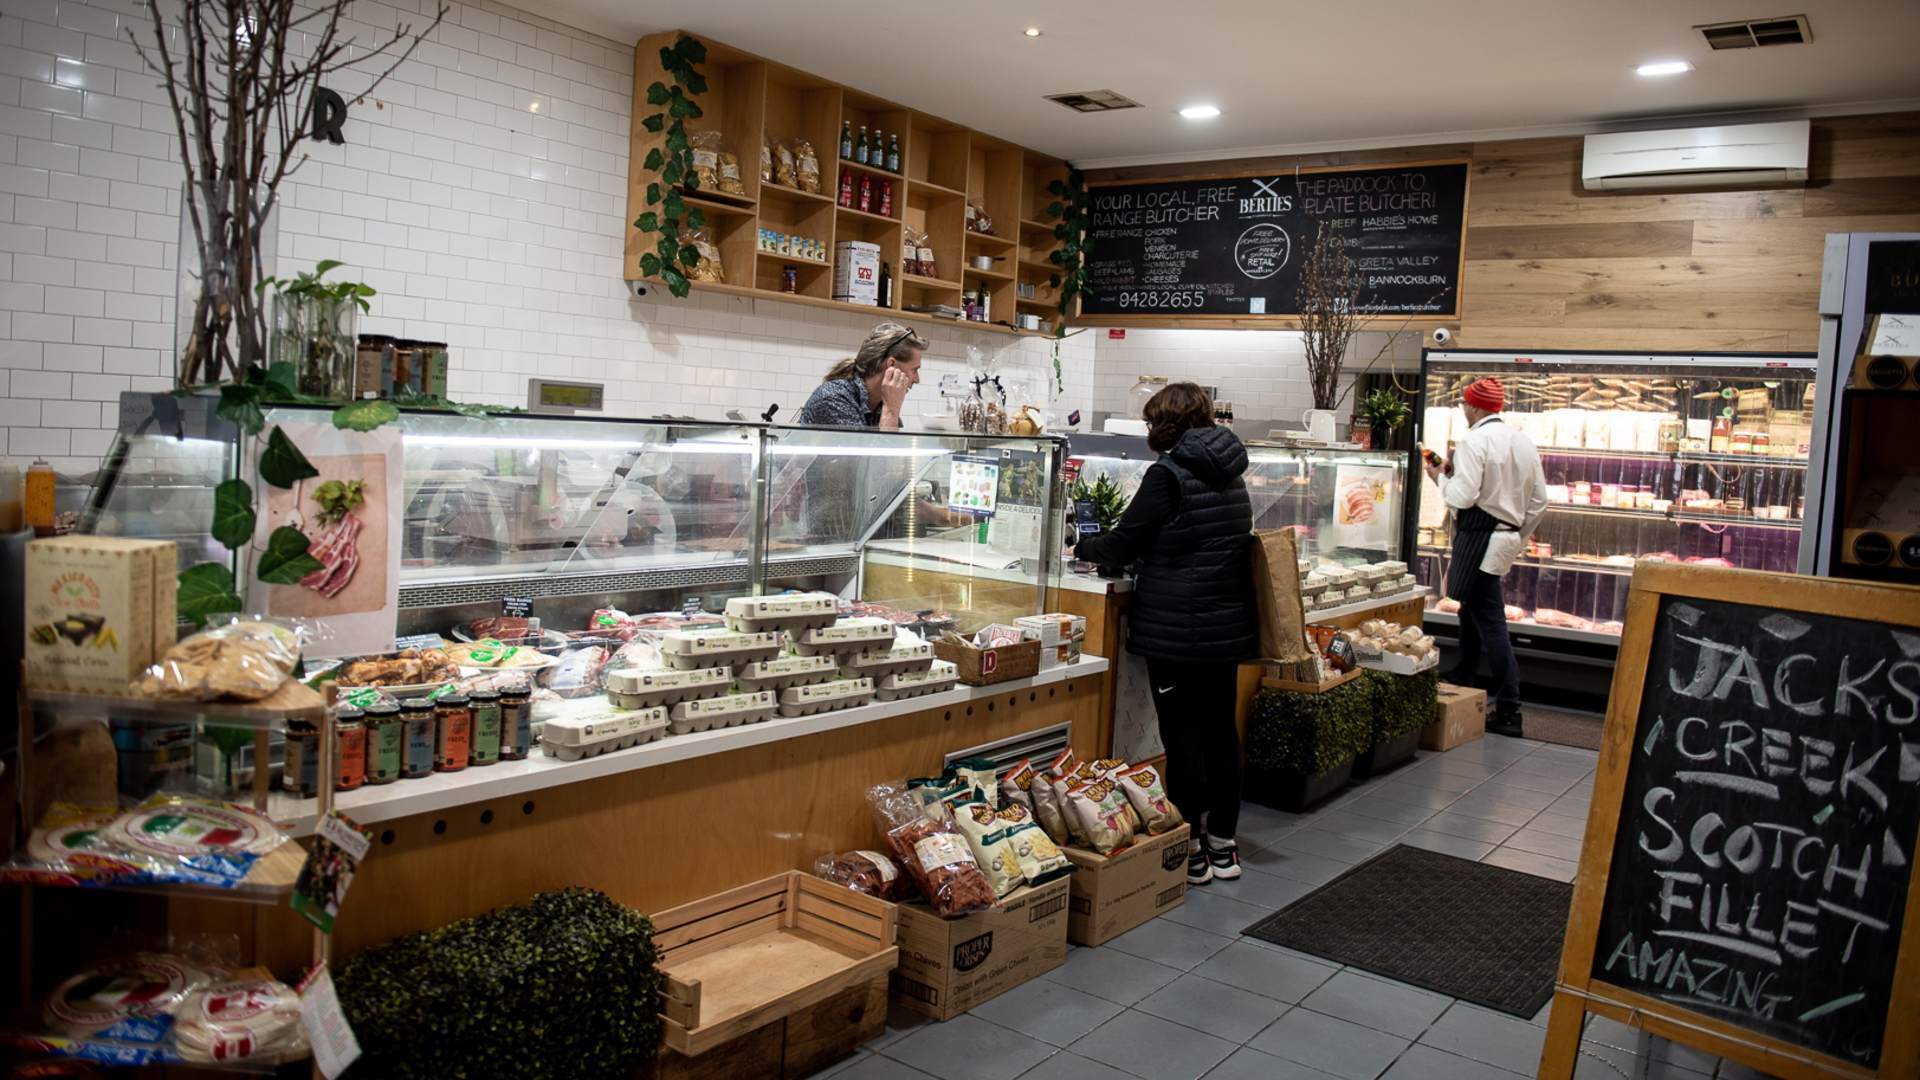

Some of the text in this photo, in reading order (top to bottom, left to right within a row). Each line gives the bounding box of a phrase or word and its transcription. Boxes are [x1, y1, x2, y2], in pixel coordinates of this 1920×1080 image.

[313, 86, 347, 145] R
[1297, 173, 1426, 196] THE PADDOCK TO
[1094, 194, 1132, 210] YOUR
[1197, 186, 1237, 204] FREE
[1239, 195, 1292, 214] BERTIES
[1304, 192, 1437, 214] PLATE BUTCHER!
[1094, 206, 1220, 226] RANGE BUTCHER
[1407, 214, 1439, 225] HOWE
[1247, 258, 1275, 267] RETAIL
[1359, 257, 1394, 268] GRETA
[1396, 256, 1439, 266] VALLEY
[1144, 275, 1179, 284] CHEESES
[1369, 275, 1446, 286] BANNOCKBURN
[983, 649, 998, 675] D
[1669, 633, 1920, 725] JACKS
[1676, 717, 1888, 811] CREEK
[1639, 786, 1872, 899] SCOTCH
[1654, 870, 1889, 965] FILLET
[913, 951, 942, 970] Chives
[1605, 931, 1792, 1019] AMAZING
